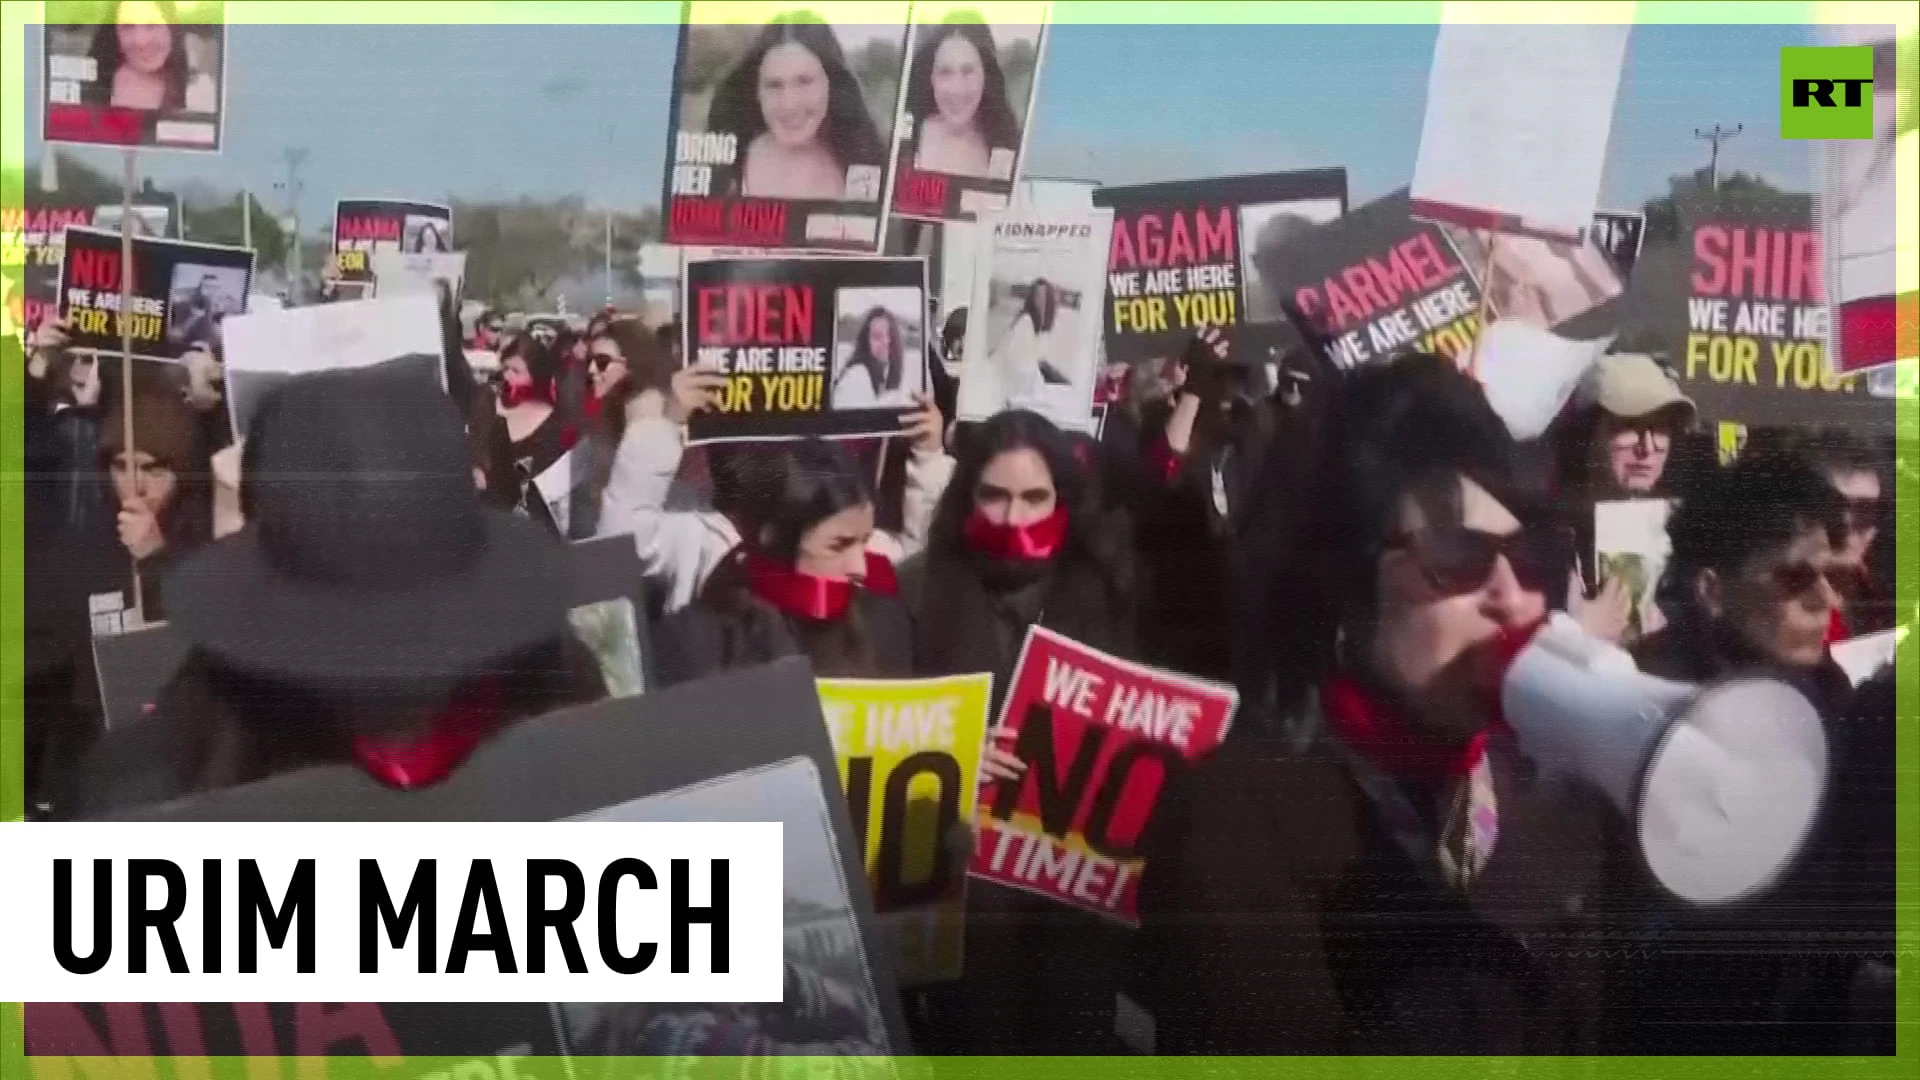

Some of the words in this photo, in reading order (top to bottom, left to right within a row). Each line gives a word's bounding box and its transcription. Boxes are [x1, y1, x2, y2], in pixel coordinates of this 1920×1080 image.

[1108, 206, 1235, 270] AGAM
[1691, 226, 1826, 303] SHIR
[70, 248, 122, 289] NO
[1109, 273, 1139, 297] WE
[1144, 268, 1183, 294] ARE
[1186, 263, 1236, 290] HERE
[1295, 232, 1464, 330] CARMEL
[69, 306, 109, 335] FOR
[698, 284, 815, 344] EDEN
[1114, 298, 1168, 334] FOR
[1173, 291, 1236, 330] YOU!
[1324, 331, 1371, 370] WE
[1366, 308, 1418, 354] ARE
[1412, 280, 1473, 330] HERE
[1687, 297, 1729, 332] WE
[1733, 302, 1786, 337] ARE
[1793, 305, 1830, 340] HE
[734, 347, 774, 373] ARE
[778, 347, 826, 372] HERE
[1686, 333, 1758, 386] FOR
[718, 375, 752, 412] OR
[762, 373, 824, 412] YOU!
[830, 703, 857, 753] E
[865, 696, 962, 753] HAVE
[1042, 656, 1106, 719] WE
[1105, 682, 1202, 750] HAVE
[991, 703, 1185, 861] NO
[988, 828, 1130, 909] TIME!
